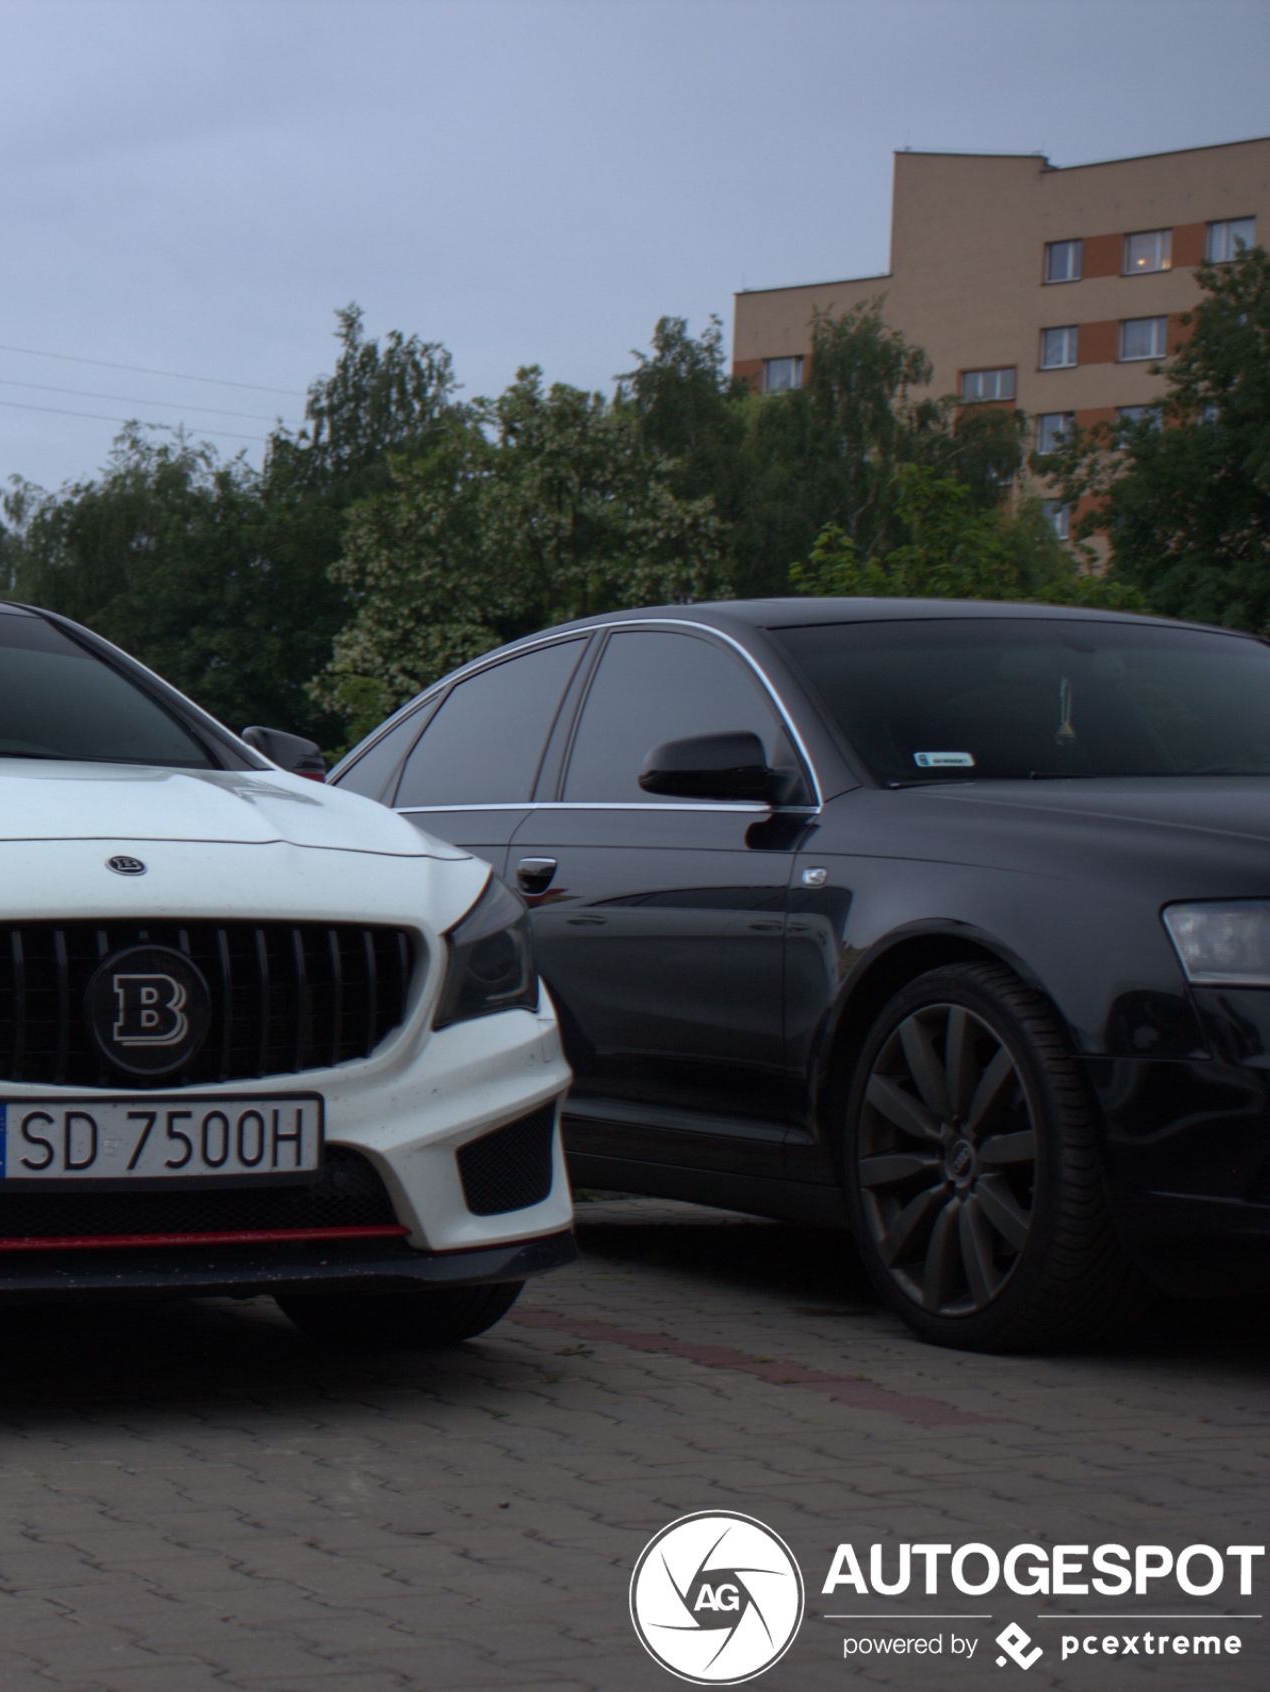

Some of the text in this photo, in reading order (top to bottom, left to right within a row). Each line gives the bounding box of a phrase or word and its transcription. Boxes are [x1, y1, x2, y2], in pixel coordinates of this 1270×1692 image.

[113, 974, 189, 1046] B
[19, 1107, 304, 1172] SD 7500H
